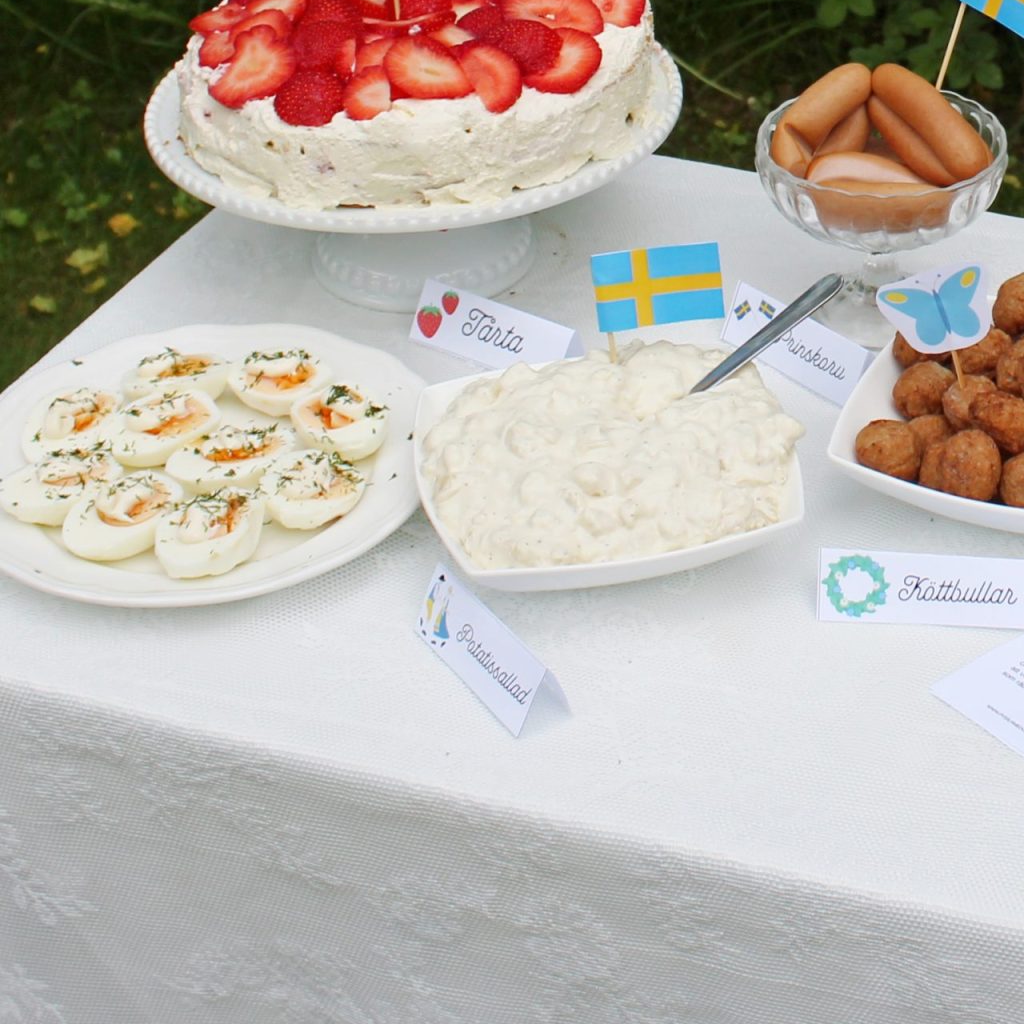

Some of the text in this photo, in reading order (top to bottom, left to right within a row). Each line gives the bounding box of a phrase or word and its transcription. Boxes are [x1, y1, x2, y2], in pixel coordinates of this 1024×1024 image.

[461, 308, 525, 355] Tårta
[898, 575, 1018, 605] Köttbullar
[456, 624, 532, 705] Potatissallad
